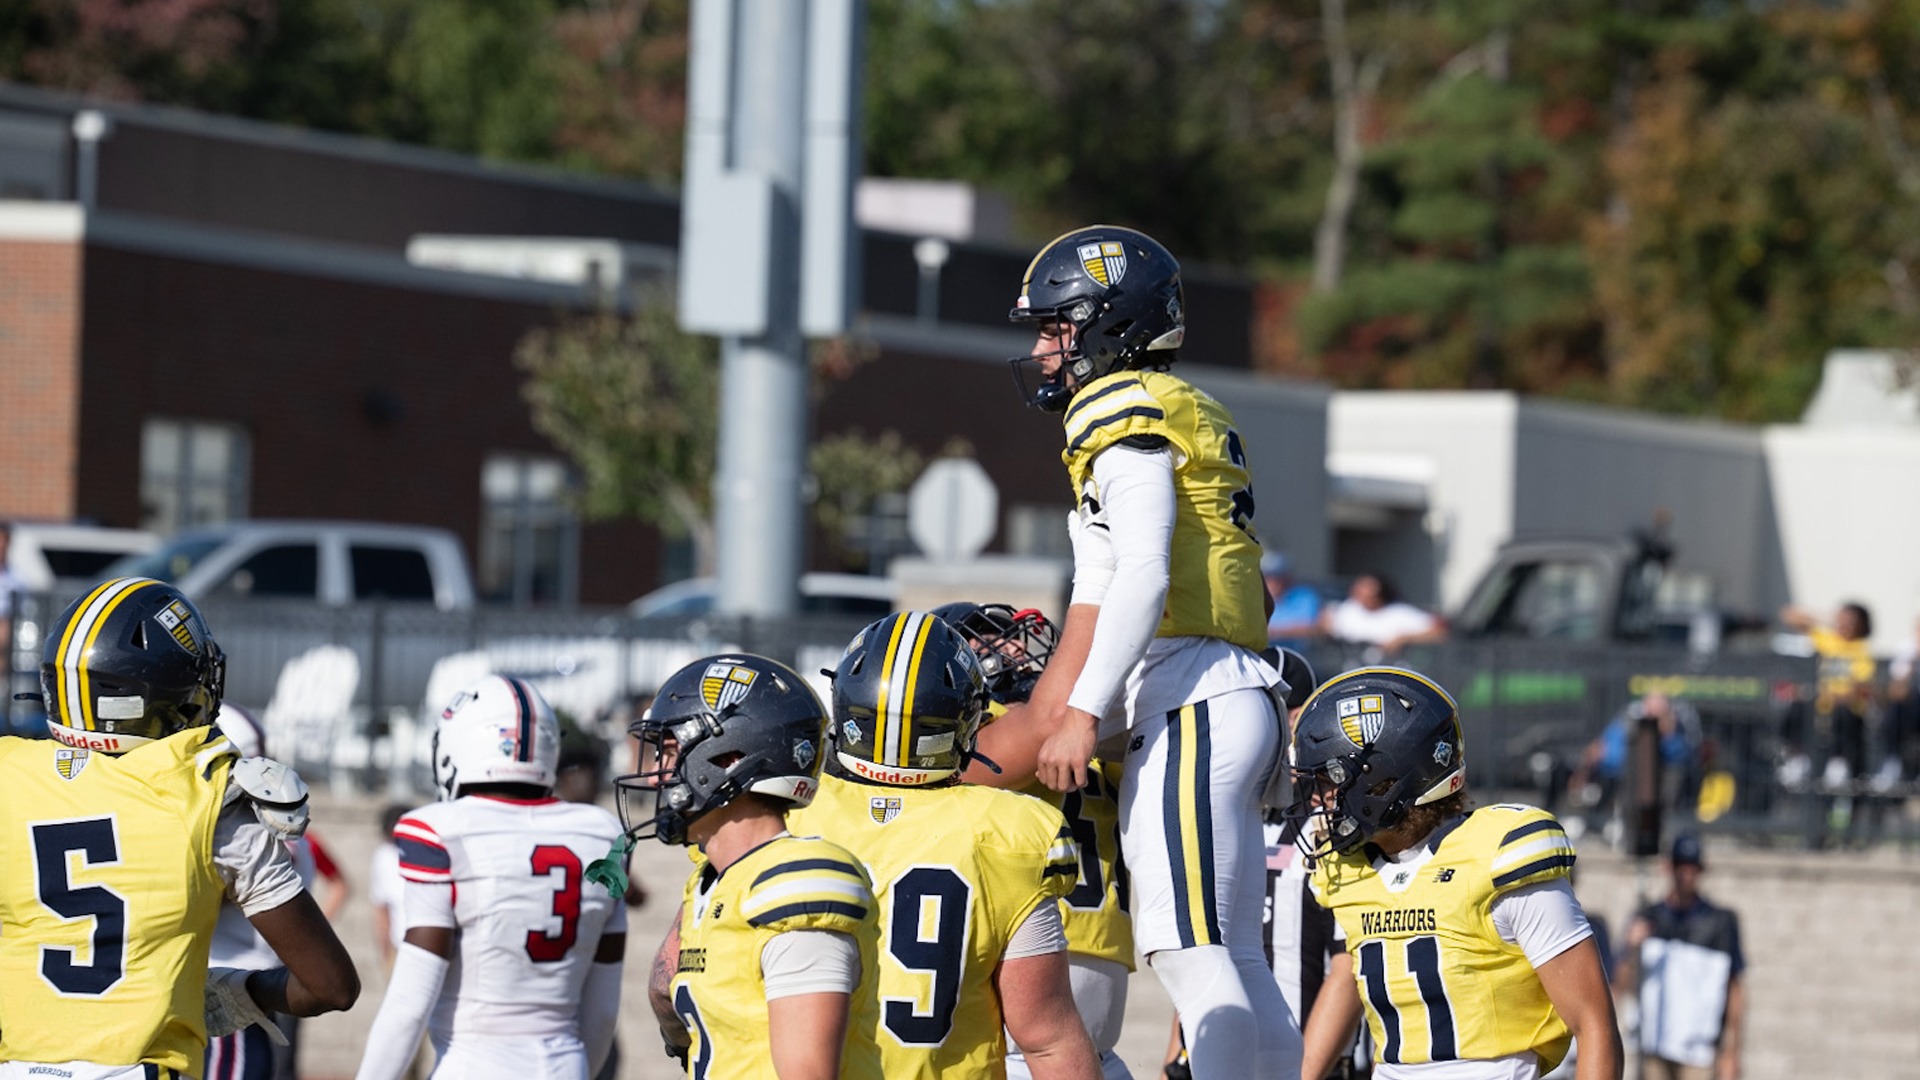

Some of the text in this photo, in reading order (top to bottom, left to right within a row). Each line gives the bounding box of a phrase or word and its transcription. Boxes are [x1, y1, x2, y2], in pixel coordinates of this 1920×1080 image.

[855, 761, 928, 784] Riddell
[27, 814, 127, 998] 5
[525, 844, 583, 963] 3
[863, 862, 973, 1048] 9
[1361, 908, 1437, 935] WARRIORS
[1358, 934, 1460, 1064] 11
